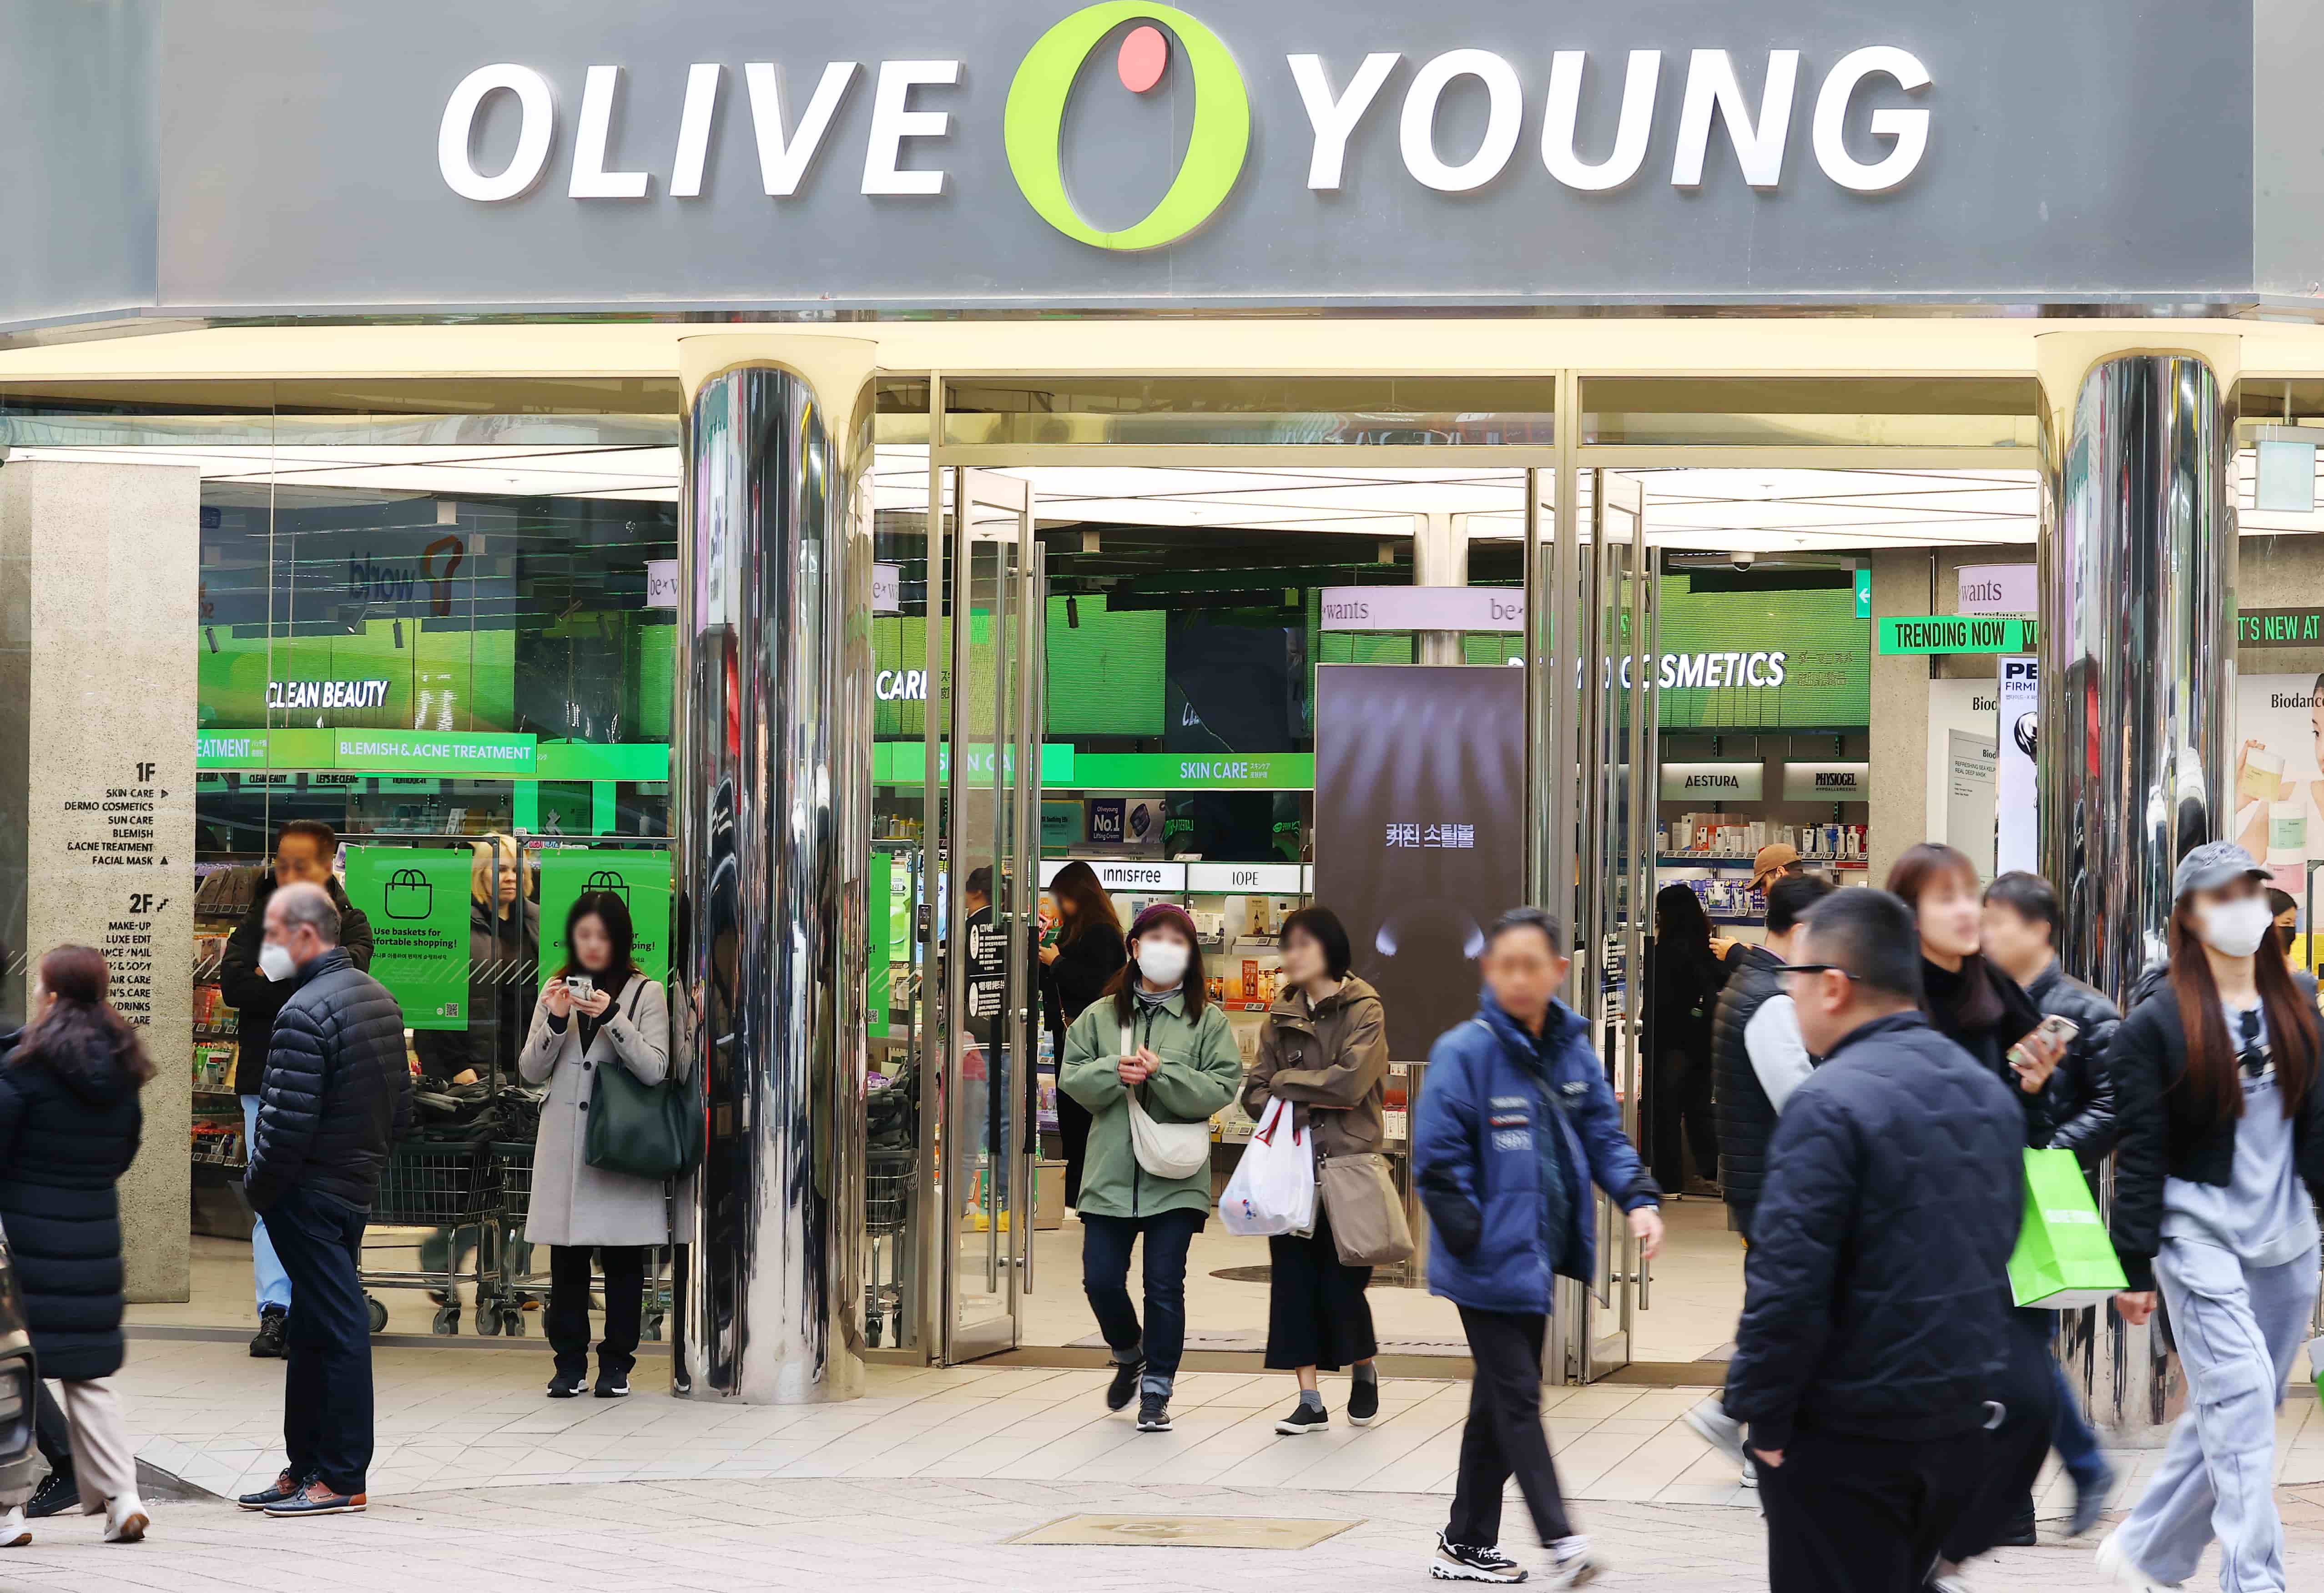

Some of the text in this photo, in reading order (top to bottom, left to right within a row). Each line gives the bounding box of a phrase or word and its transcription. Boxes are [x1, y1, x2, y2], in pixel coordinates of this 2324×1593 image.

[438, 59, 960, 202] OLIVE
[1286, 45, 1931, 192] YOUNG
[2238, 615, 2320, 640] T'S NEW AT
[1895, 621, 2005, 648] TRENDING NOW
[2006, 663, 2038, 680] PE
[2005, 681, 2036, 691] FIRMI
[266, 680, 388, 708] CLEAN BEAUTY
[2271, 692, 2324, 708] Biodanc
[1973, 696, 1997, 711] Biod
[196, 738, 250, 758] EATMENT
[340, 741, 400, 756] BLEMISH
[401, 744, 410, 756] &
[413, 744, 449, 757] ACNE
[453, 744, 531, 760] TREATMENT
[1983, 749, 1996, 759] Biod
[136, 762, 156, 782] 1F
[1180, 761, 1248, 779] SKIN CARE
[1685, 775, 1739, 788] AESTURA
[1815, 773, 1857, 786] PHYSIOGEL
[106, 789, 154, 798] SKIN CARE
[65, 802, 154, 811] DERMO COSMETICS
[108, 816, 153, 825] SUN CARE
[1094, 814, 1120, 832] No.1
[113, 829, 153, 838] BLEMISH
[102, 842, 153, 852] TREATMENT
[92, 856, 153, 865] FACIAL MASK
[1232, 871, 1259, 885] IOPE
[130, 893, 153, 913] 2F
[109, 922, 151, 931] MAKE-UP
[392, 928, 426, 936] baskets
[106, 935, 151, 944] LUXE EDIT
[372, 938, 457, 949] nfortable shopping!
[632, 941, 655, 952] ping!
[110, 975, 151, 984] AIR CARE
[127, 989, 151, 998] CARE
[127, 1016, 151, 1025] CARE
